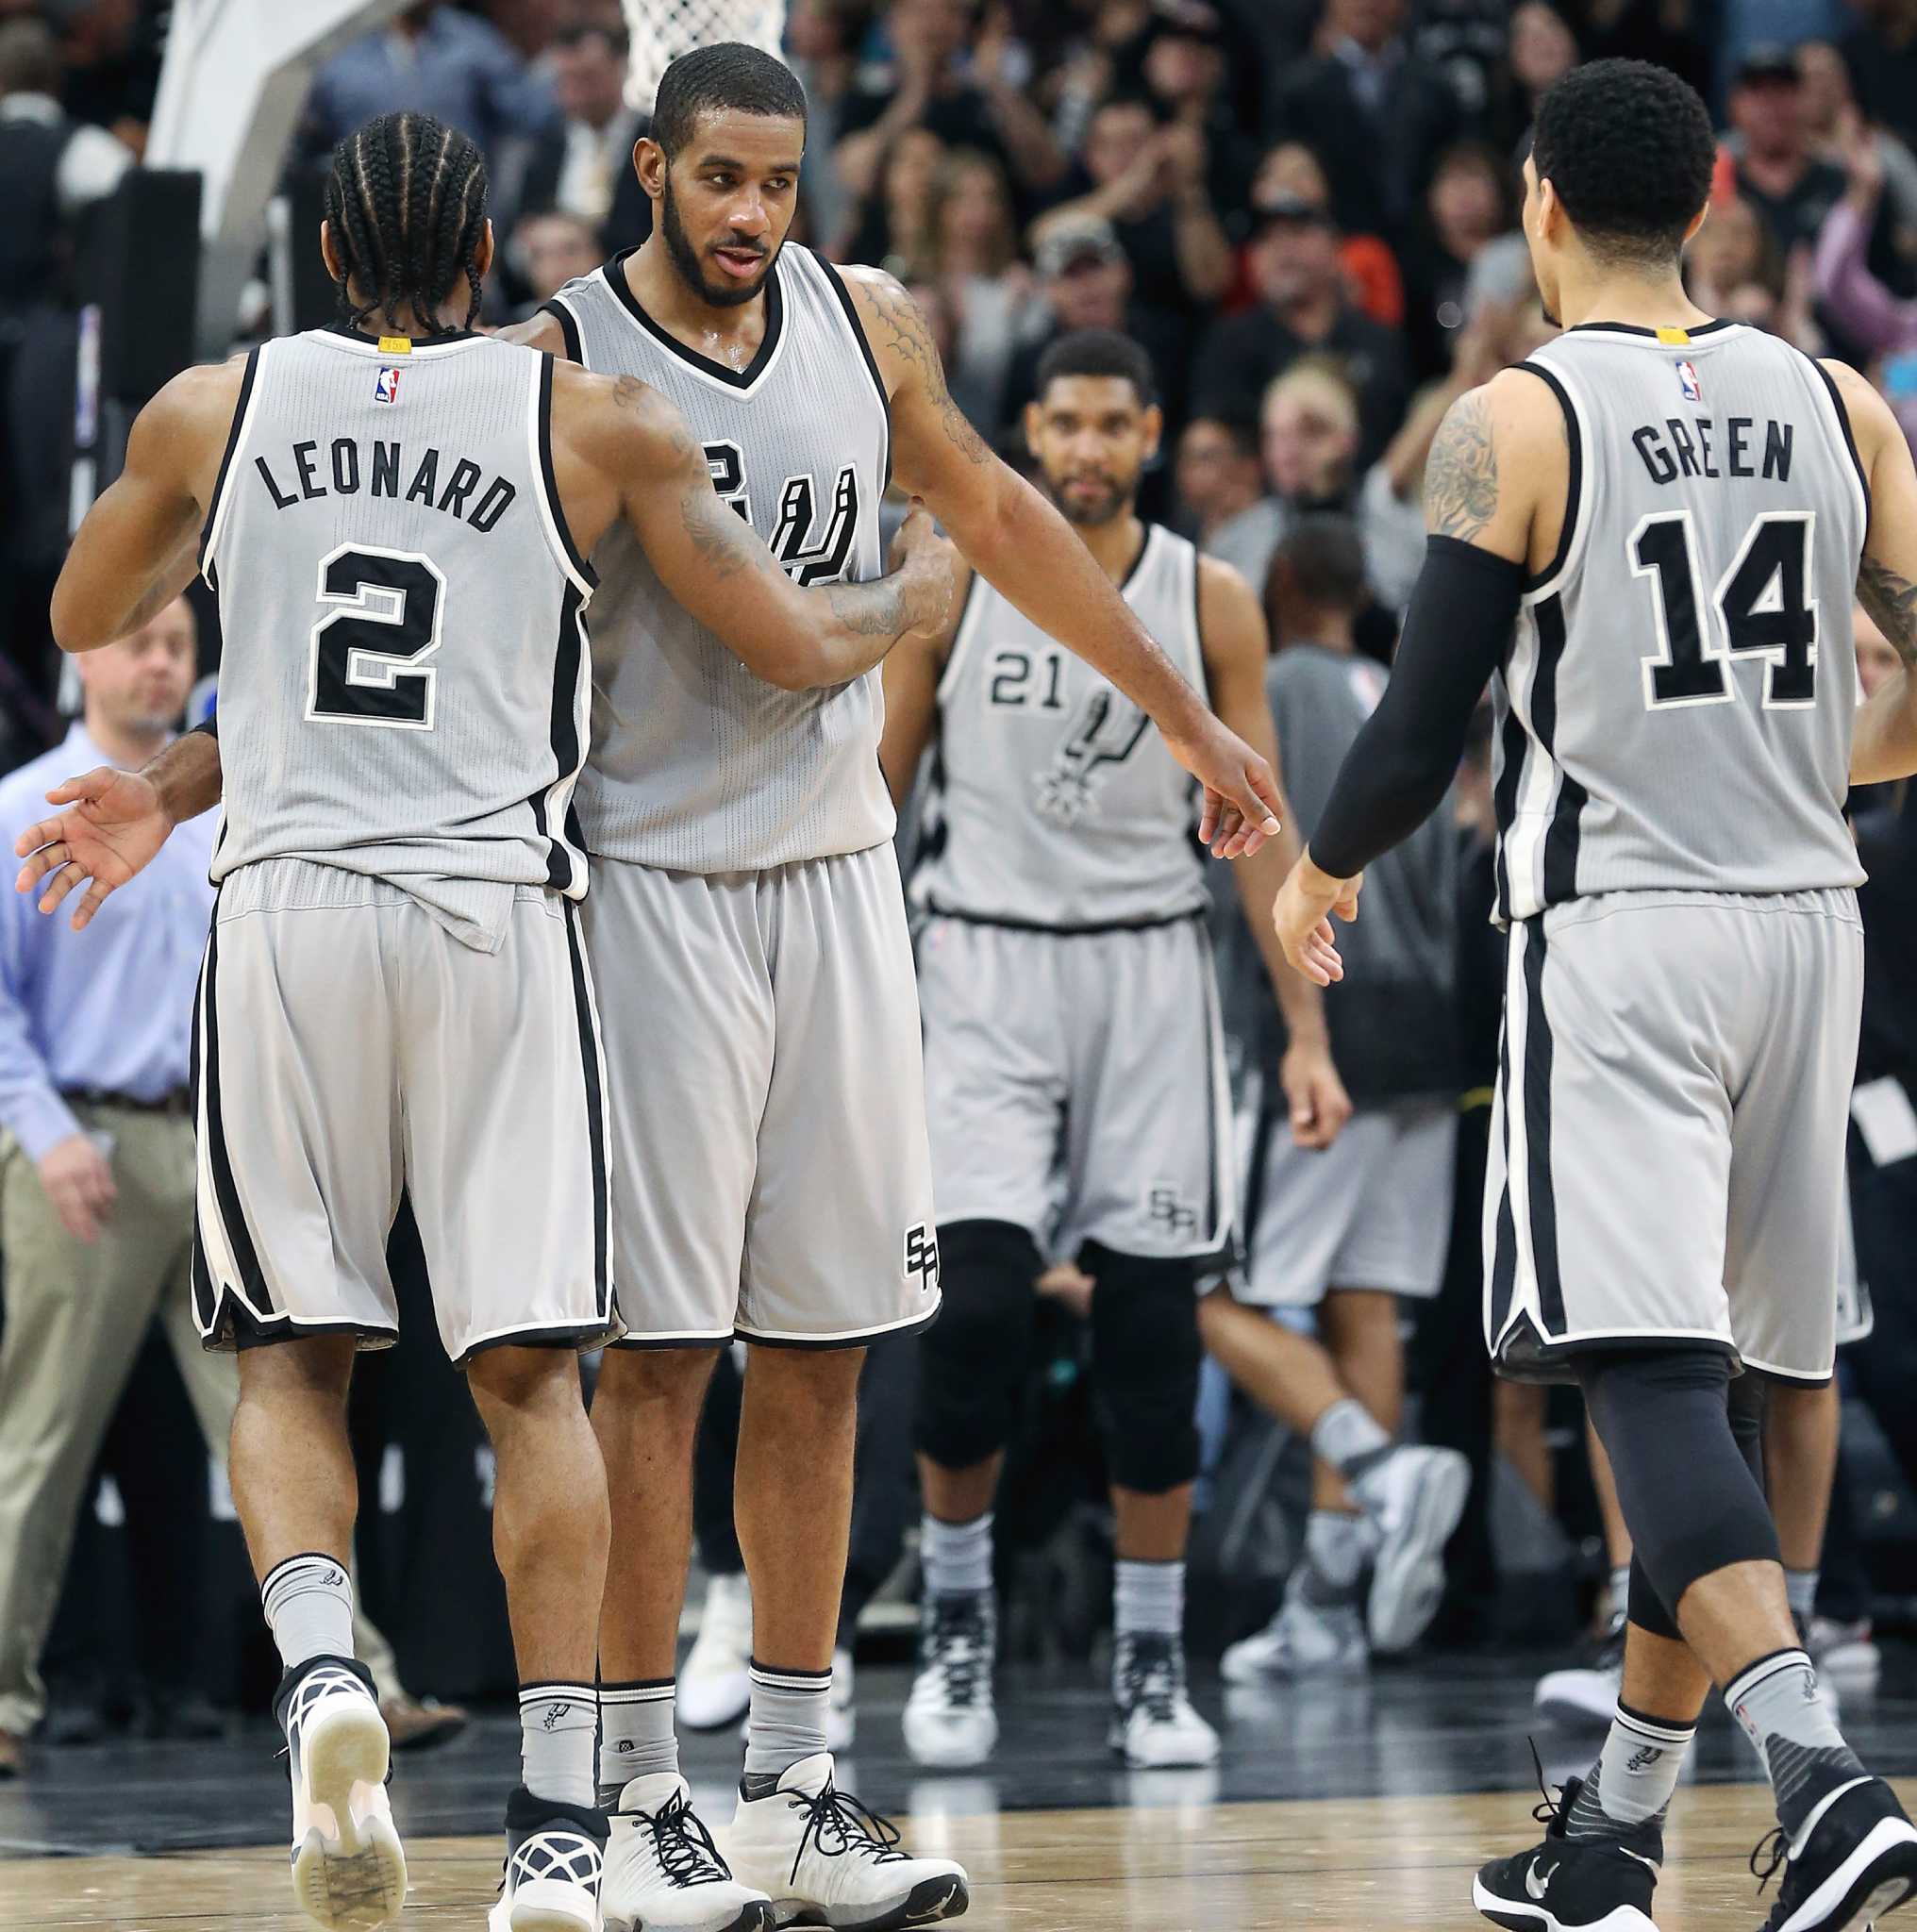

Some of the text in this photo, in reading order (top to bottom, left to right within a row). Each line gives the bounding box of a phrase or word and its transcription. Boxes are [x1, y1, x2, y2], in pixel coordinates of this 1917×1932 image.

[255, 438, 516, 533] LEONARD
[1632, 418, 1793, 485] GREEN
[304, 541, 448, 731] 2
[1625, 509, 1819, 710] 14
[991, 652, 1063, 708] 21
